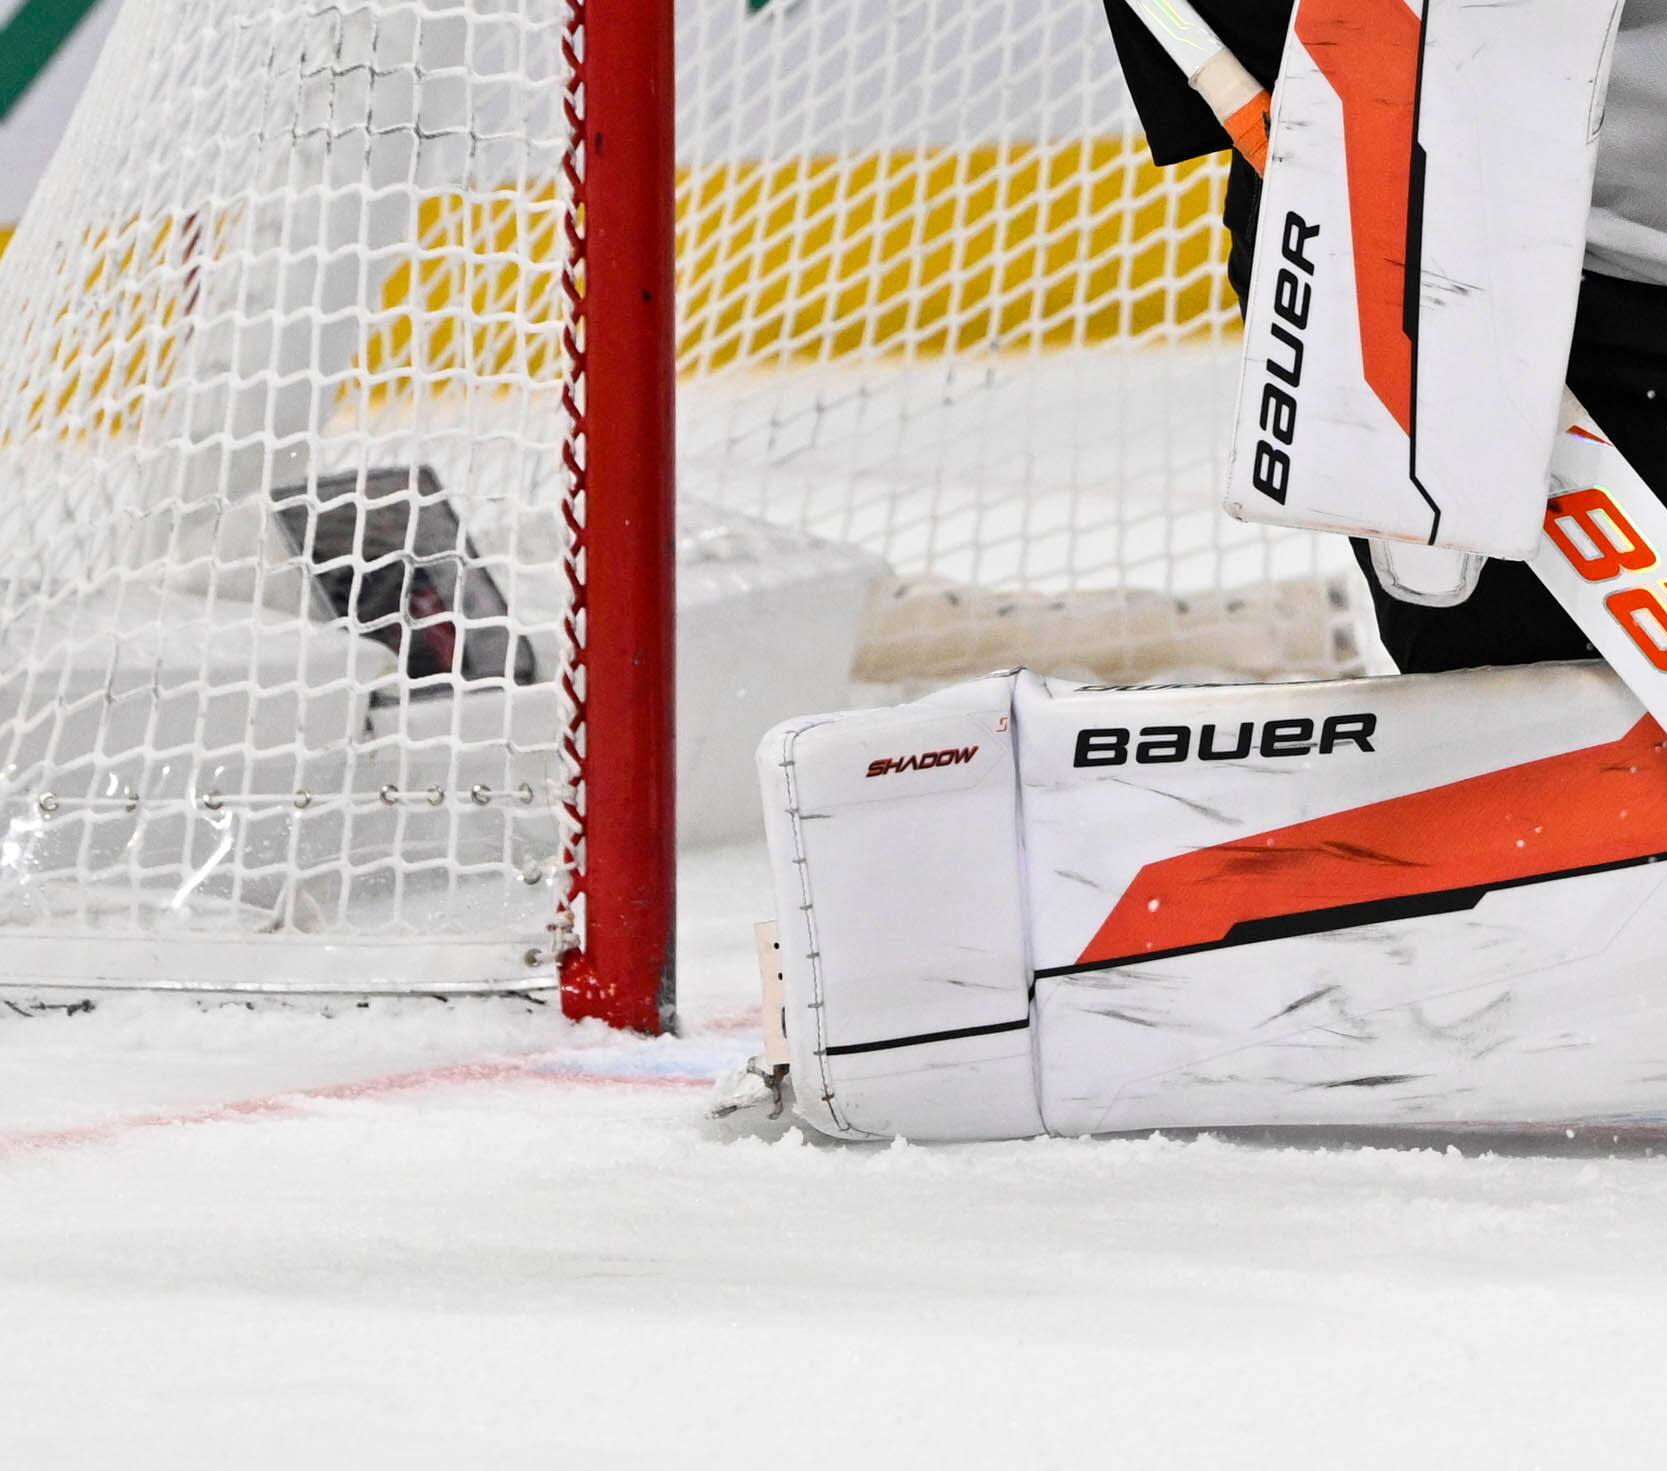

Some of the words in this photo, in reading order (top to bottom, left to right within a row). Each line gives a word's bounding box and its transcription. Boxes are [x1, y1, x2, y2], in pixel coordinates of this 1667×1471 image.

[1252, 210, 1321, 506] BAUER
[864, 744, 980, 778] SHADOW
[1072, 712, 1377, 769] BAUER
